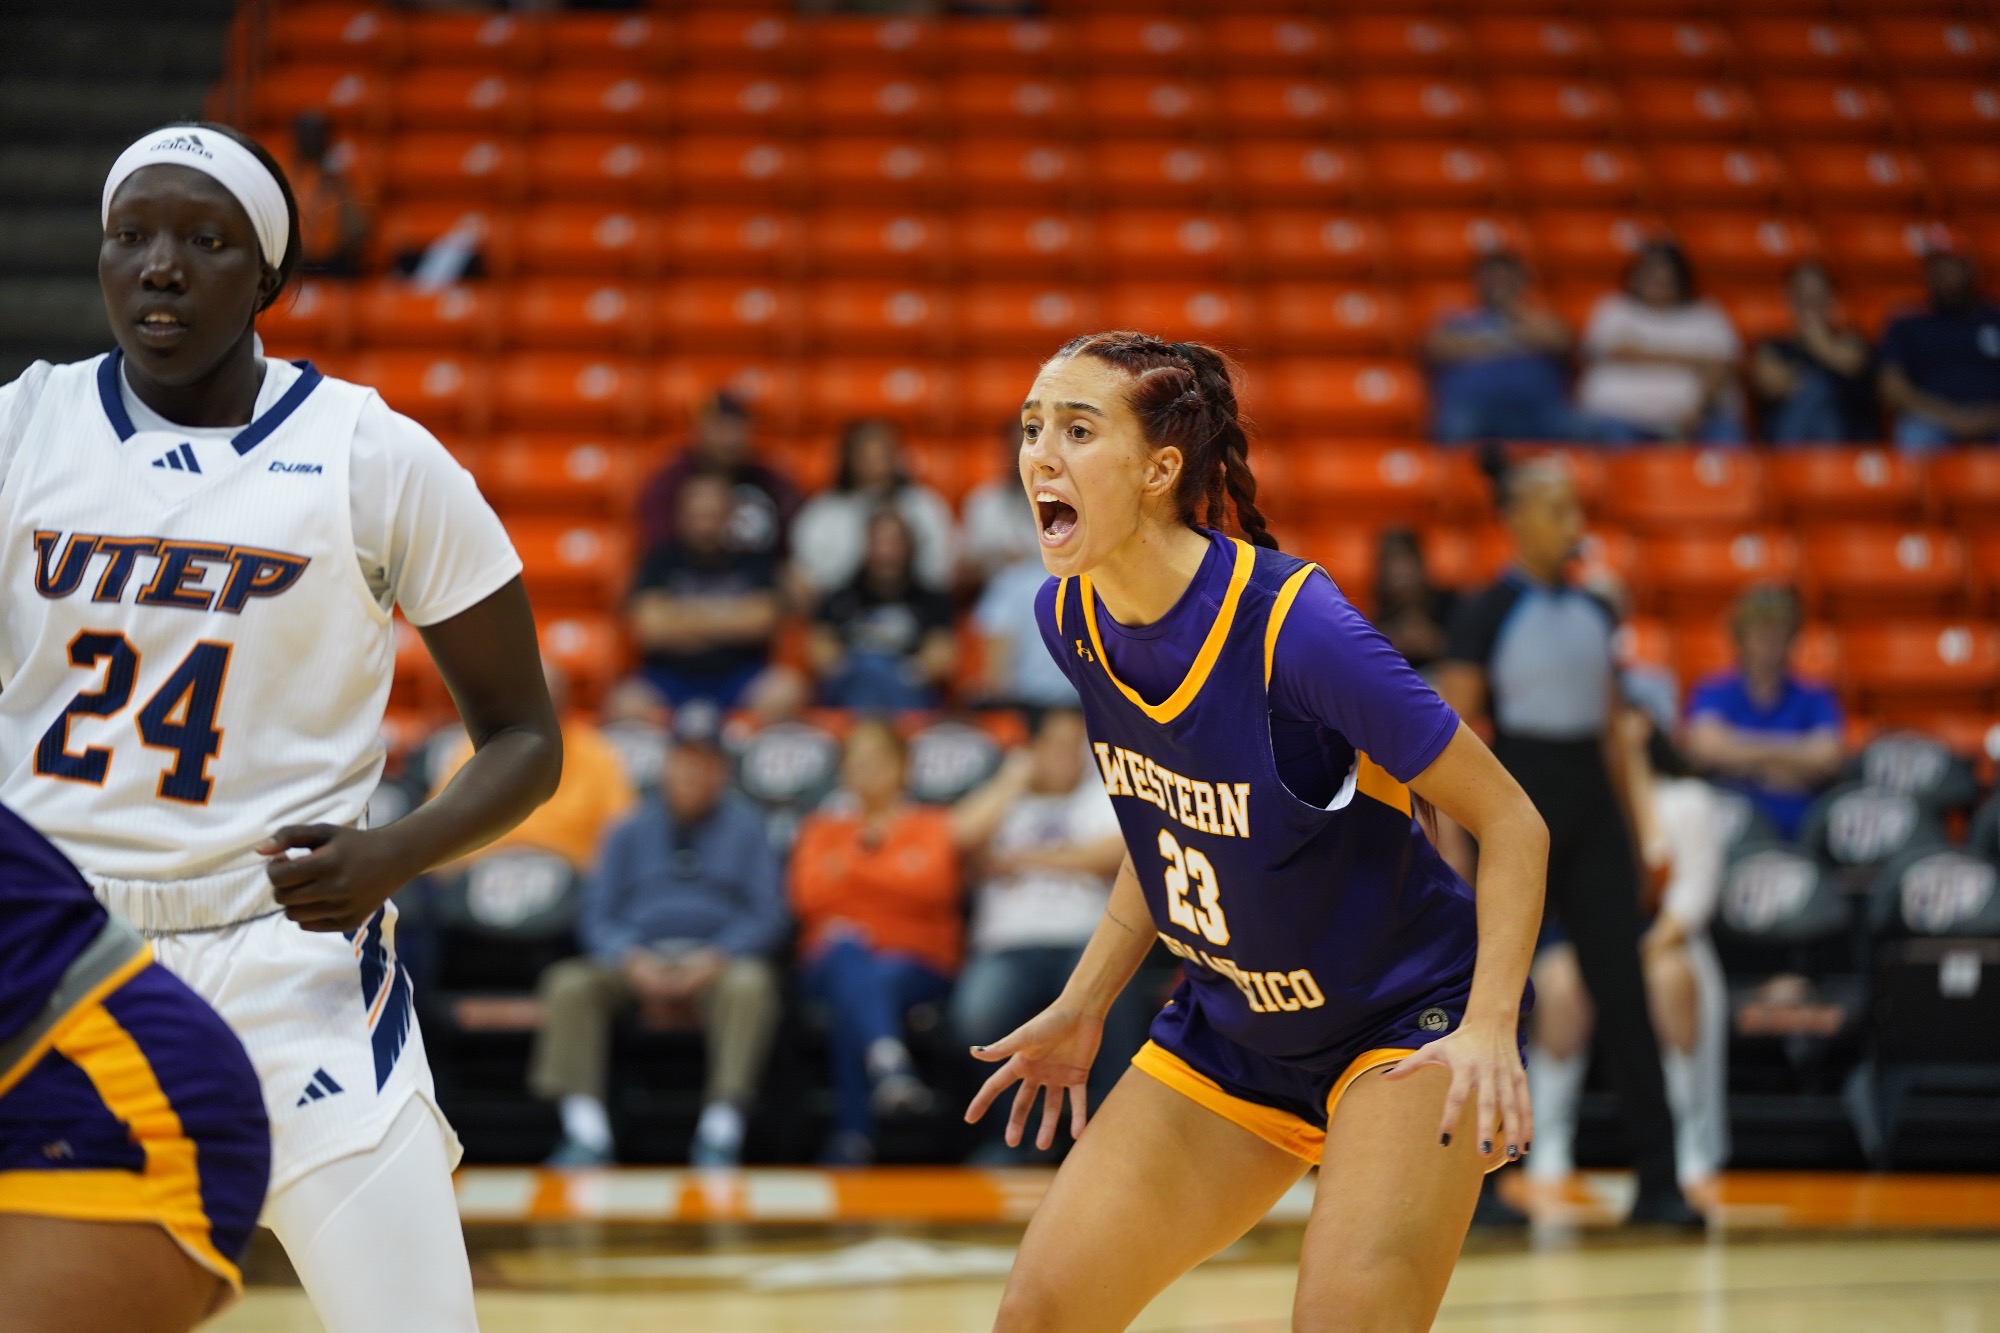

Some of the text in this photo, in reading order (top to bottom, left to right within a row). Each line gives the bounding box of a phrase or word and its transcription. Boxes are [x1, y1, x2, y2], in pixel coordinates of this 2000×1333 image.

[149, 140, 214, 160] adidas
[33, 530, 312, 616] UTEP
[32, 627, 234, 807] 24
[1093, 741, 1251, 839] WESTERN
[1157, 828, 1231, 946] 23
